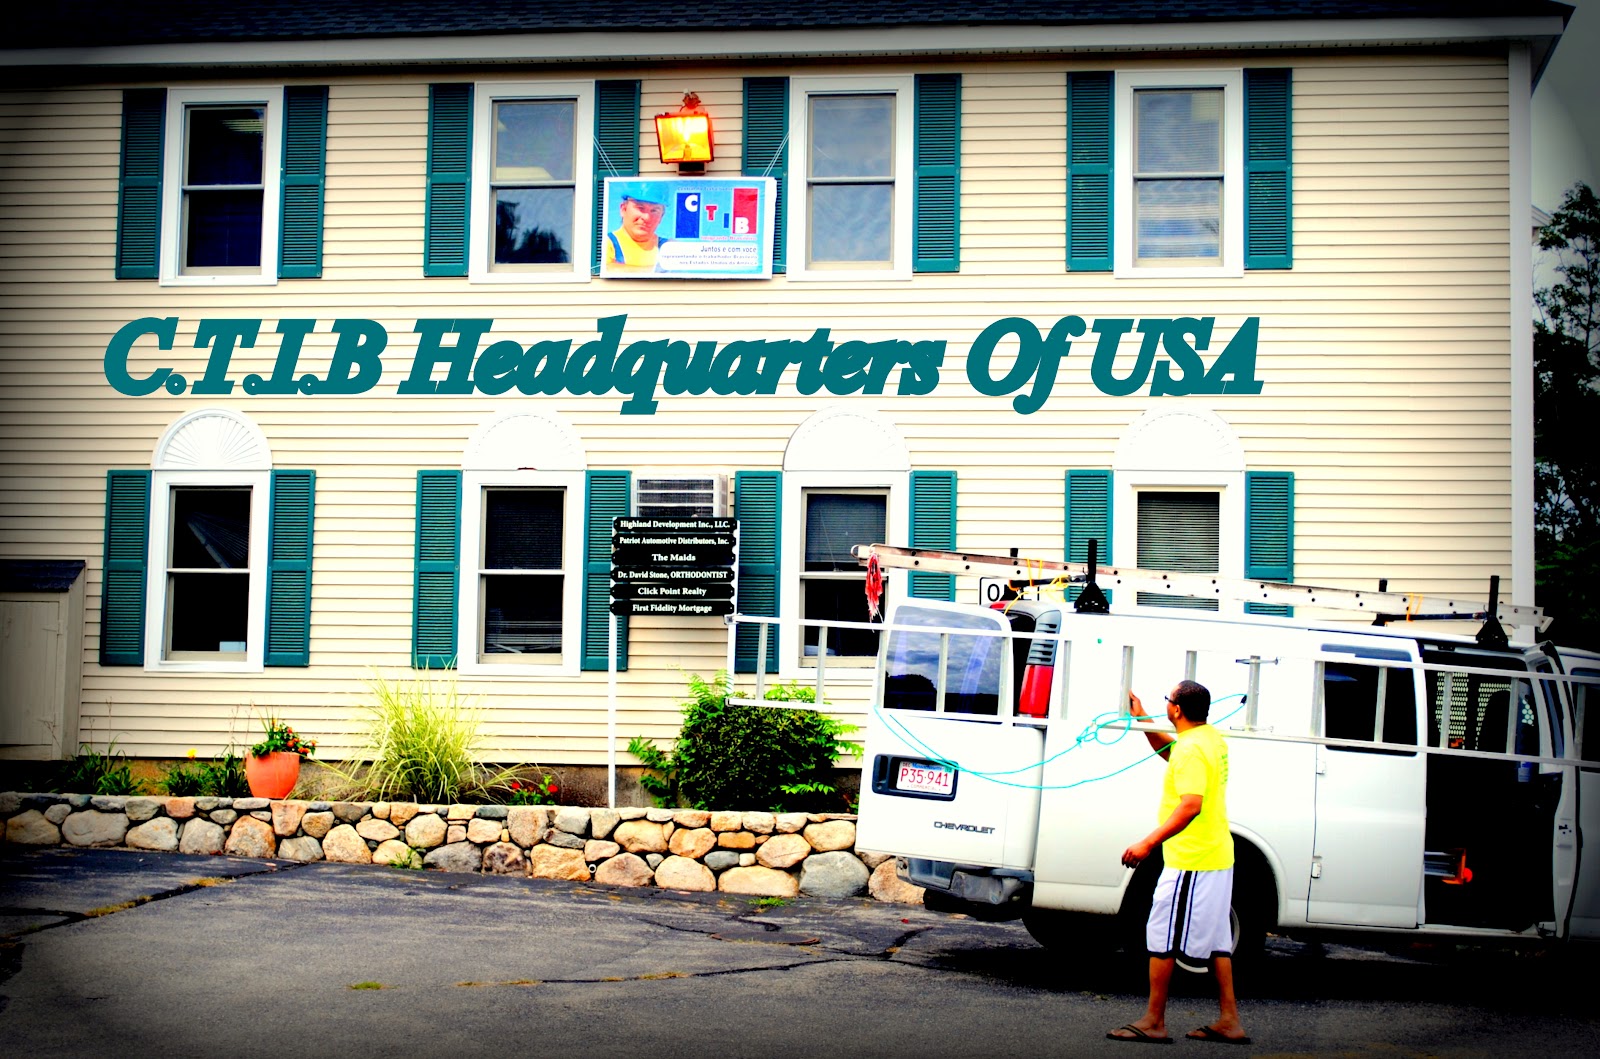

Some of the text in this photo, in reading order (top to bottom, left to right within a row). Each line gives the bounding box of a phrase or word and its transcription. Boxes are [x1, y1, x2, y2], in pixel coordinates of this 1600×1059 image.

[700, 245, 721, 253] Juntos
[620, 520, 651, 529] Highland
[652, 520, 697, 529] Development
[714, 520, 730, 528] LLC.
[619, 537, 729, 545] Patriot Automotive Distributors, Inc.
[670, 553, 696, 561] Maids
[649, 571, 669, 579] Stone,
[637, 587, 707, 596] Click Point Realty
[650, 603, 677, 613] Fidelity
[678, 604, 712, 613] Mortgage
[933, 821, 995, 834] CHEVROLET
